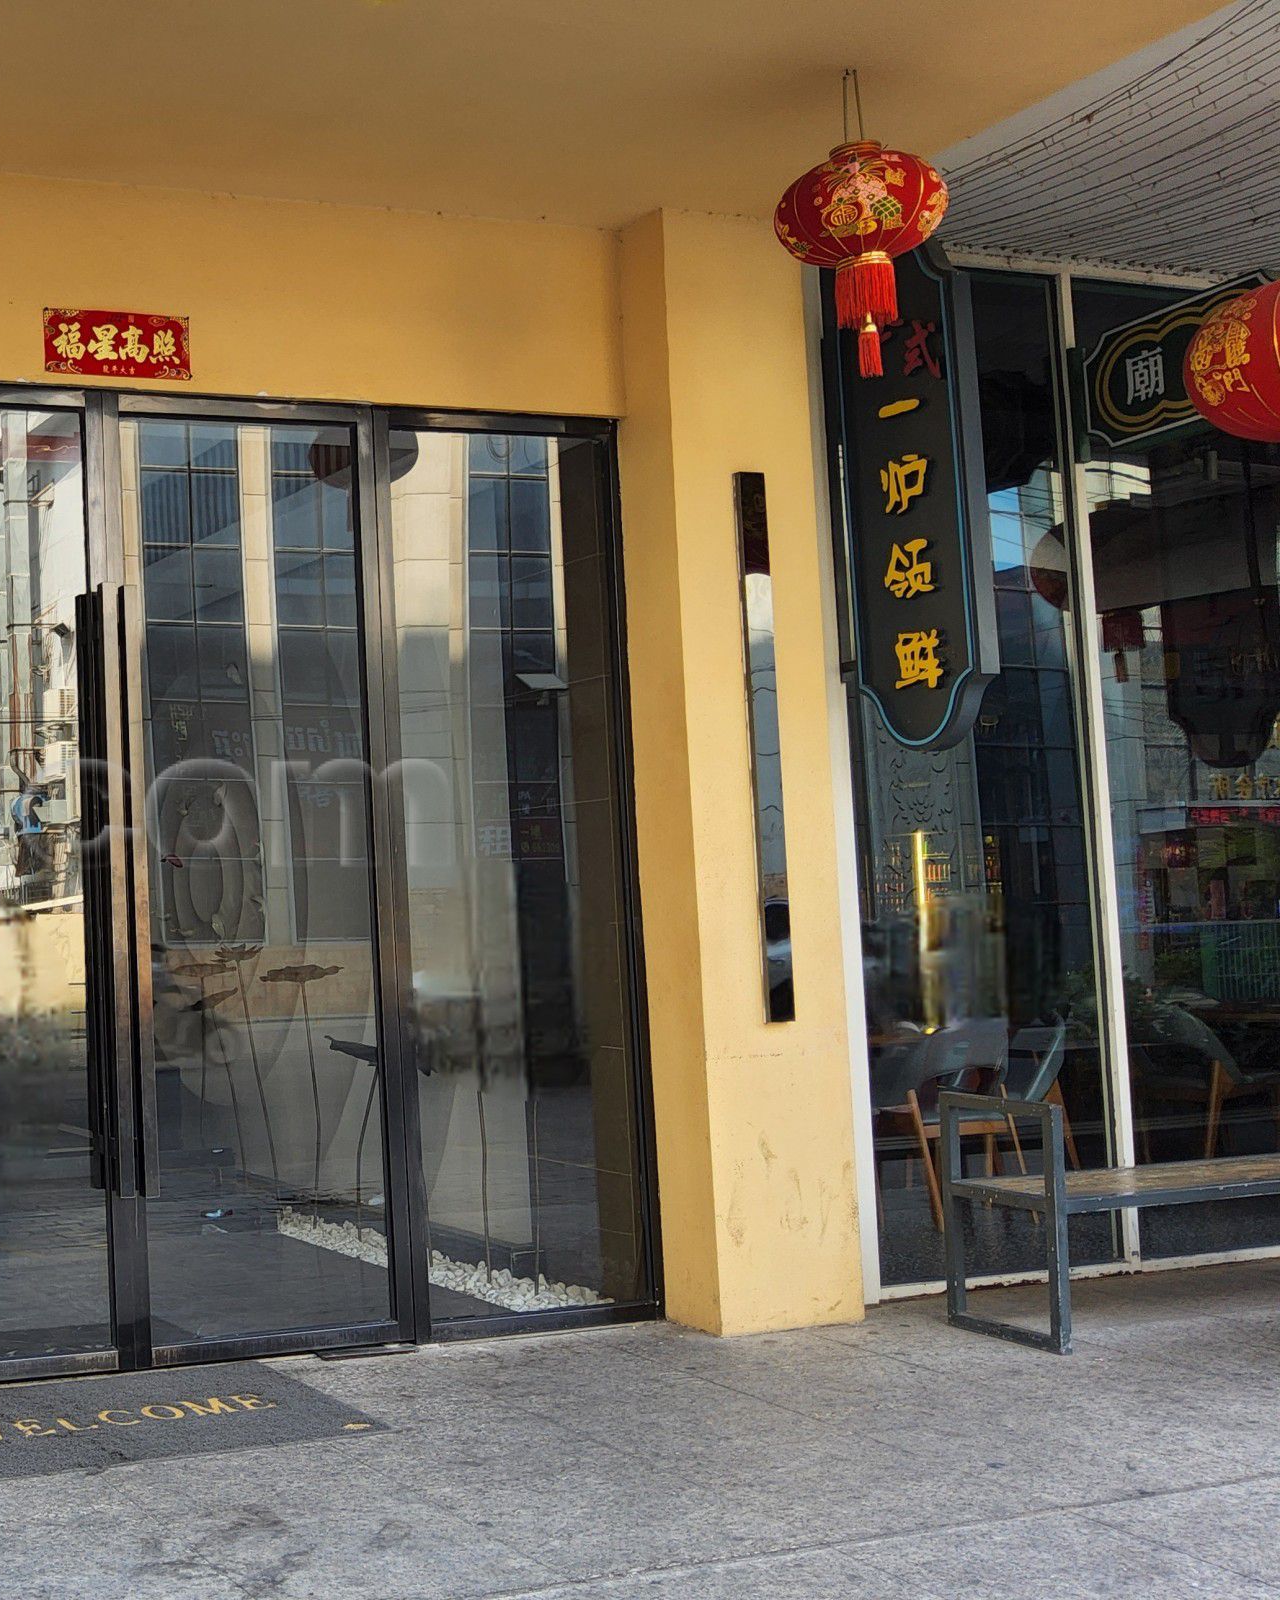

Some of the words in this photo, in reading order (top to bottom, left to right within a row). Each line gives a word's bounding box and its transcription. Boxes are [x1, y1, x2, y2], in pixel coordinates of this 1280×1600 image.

[52, 321, 181, 365] 福星高照
[1126, 346, 1165, 405] 廟
